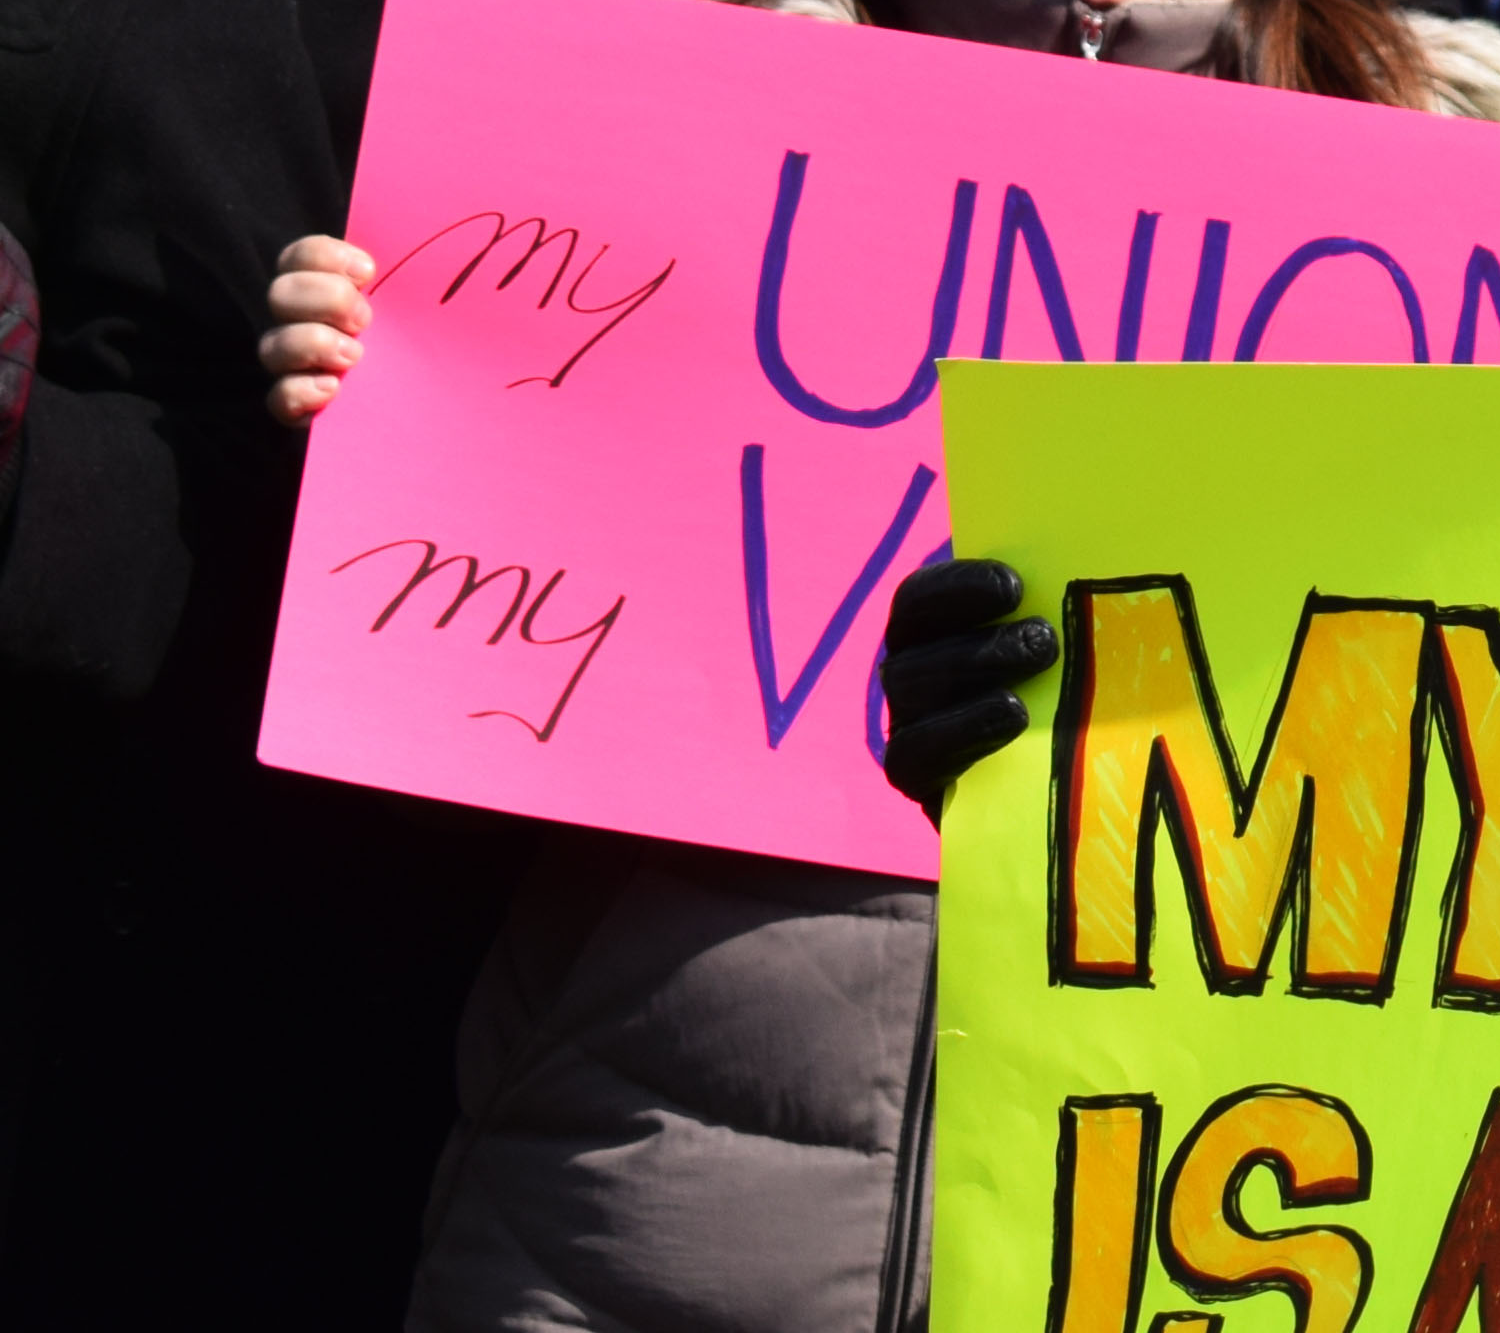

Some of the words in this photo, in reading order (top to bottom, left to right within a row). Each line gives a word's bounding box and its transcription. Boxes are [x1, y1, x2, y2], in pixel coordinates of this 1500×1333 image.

[370, 211, 676, 389] my
[330, 539, 626, 743] my
[1048, 1083, 1375, 1333] IS
